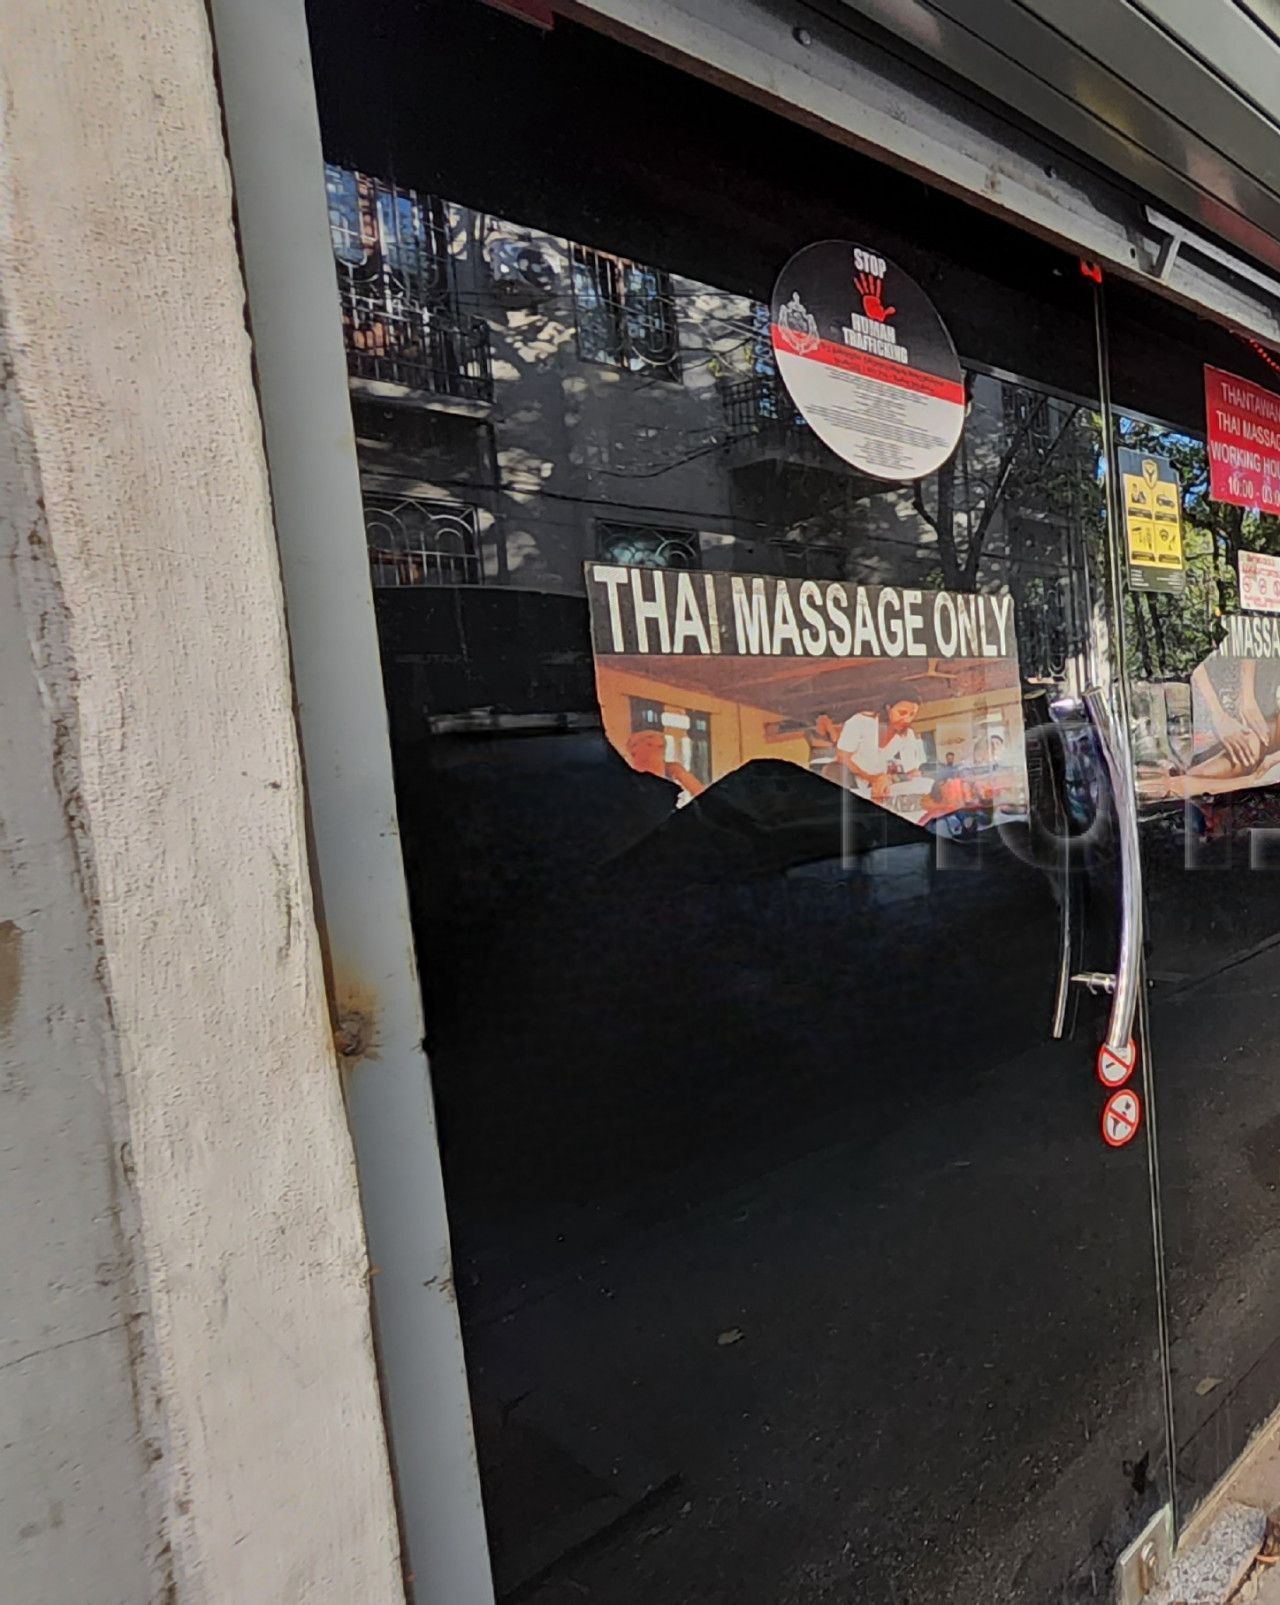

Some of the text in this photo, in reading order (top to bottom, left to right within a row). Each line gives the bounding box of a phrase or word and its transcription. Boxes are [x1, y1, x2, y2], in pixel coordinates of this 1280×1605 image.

[853, 247, 887, 279] STOP
[1216, 410, 1240, 436] THAI
[1210, 440, 1262, 472] WORKING
[593, 565, 1012, 658] THAI MASSAGE ONLY
